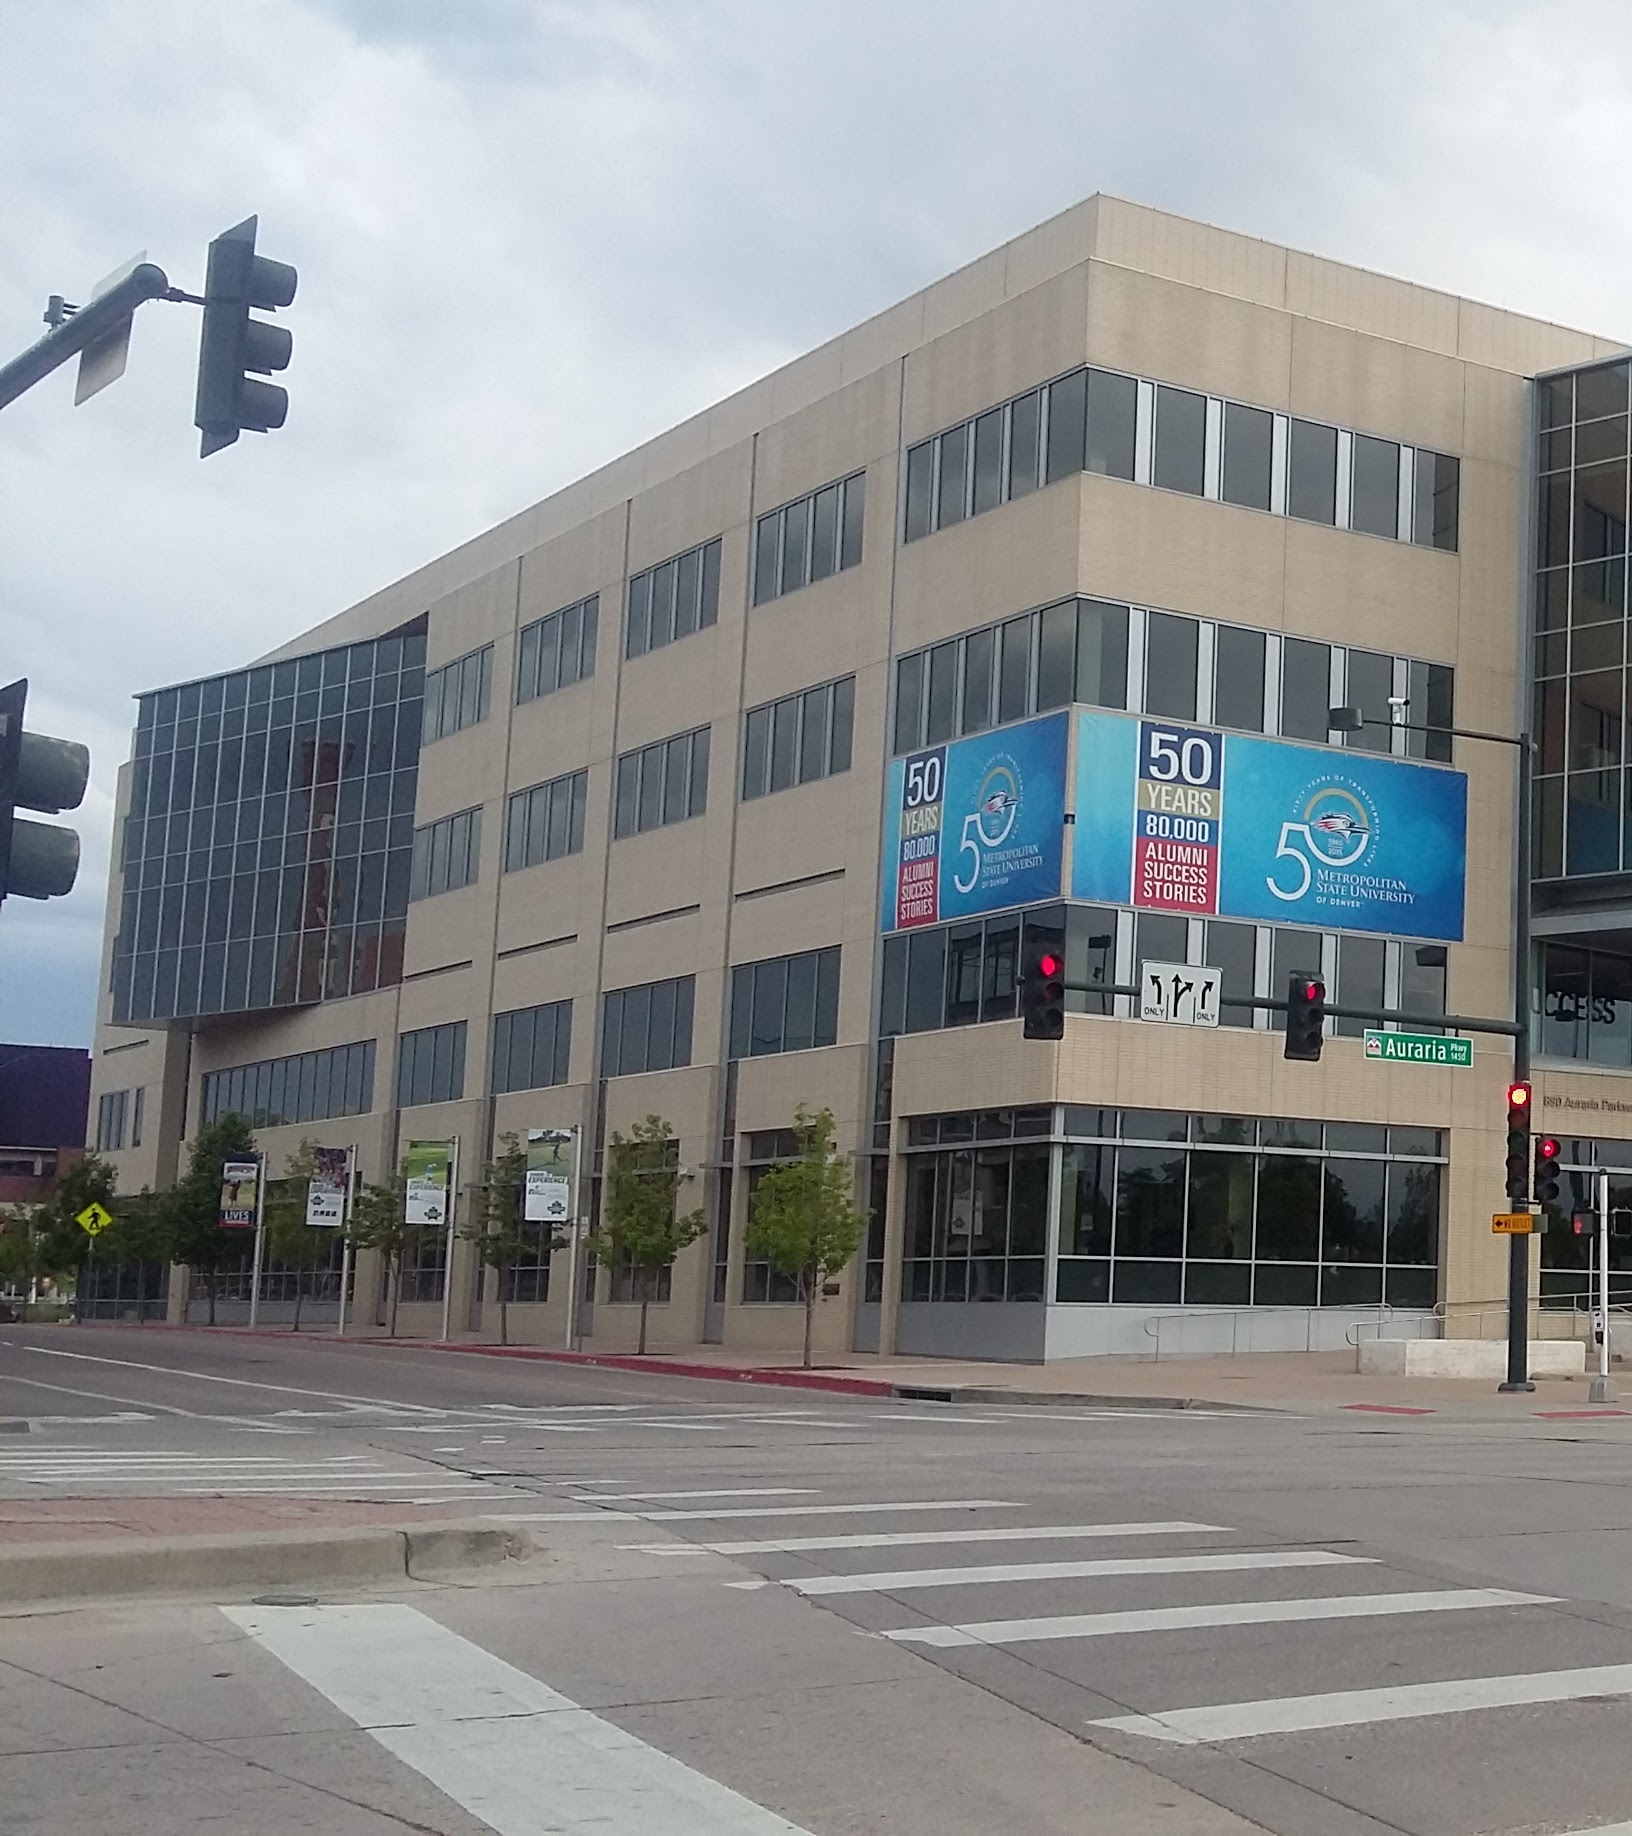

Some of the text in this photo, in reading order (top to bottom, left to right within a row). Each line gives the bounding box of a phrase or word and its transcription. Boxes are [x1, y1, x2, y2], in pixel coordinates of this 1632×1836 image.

[1149, 731, 1212, 785] 50
[907, 757, 940, 806] 50
[1147, 783, 1212, 817] YEARS
[905, 806, 938, 835] YEARS
[1146, 814, 1209, 843] 80,000
[904, 835, 935, 861] 80,000
[983, 844, 1039, 863] METROPOLITAN
[1145, 842, 1208, 866] ALUMNI
[902, 862, 934, 882] ALUMNI
[982, 856, 1043, 877] STATE UNIVERSITY
[1144, 861, 1208, 885] SUCCESS
[902, 880, 934, 901] SUCCESS
[1317, 868, 1407, 891] METROPOLITAN
[1143, 881, 1207, 904] STORIES
[1316, 881, 1416, 904] STATE UNIVERSITY
[1316, 896, 1361, 908] OF DENVER
[901, 899, 933, 920] STORIES
[1144, 1006, 1165, 1016] ONLY
[1196, 1012, 1215, 1021] ONLY
[1385, 1037, 1467, 1060] Auraria Pkwy
[1564, 1097, 1599, 1110] Auraria
[224, 1210, 250, 1220] LIVES
